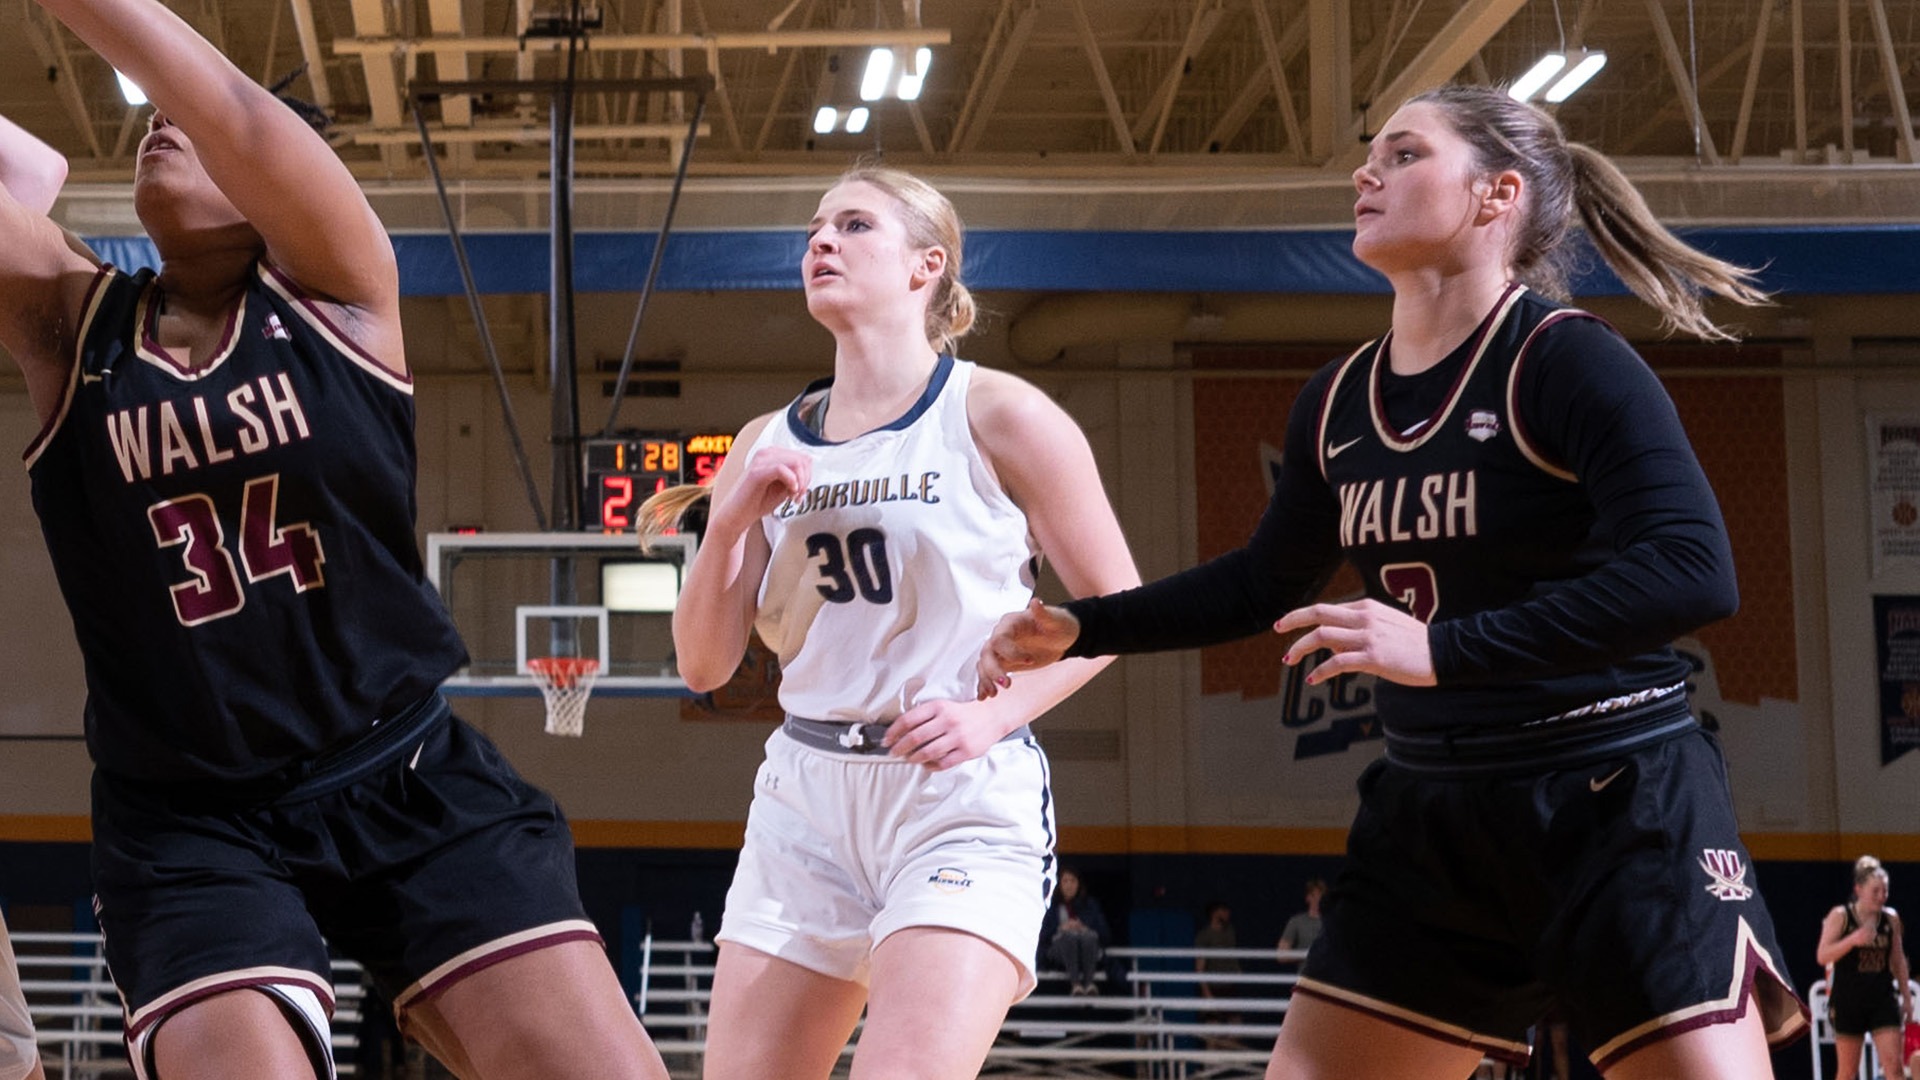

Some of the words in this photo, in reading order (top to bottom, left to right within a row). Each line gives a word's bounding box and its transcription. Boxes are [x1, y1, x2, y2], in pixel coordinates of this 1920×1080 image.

[106, 372, 310, 483] WALSH
[776, 470, 941, 521] EDARVILLE
[1339, 469, 1478, 548] WALSH
[147, 473, 326, 627] 34
[806, 527, 893, 605] 30
